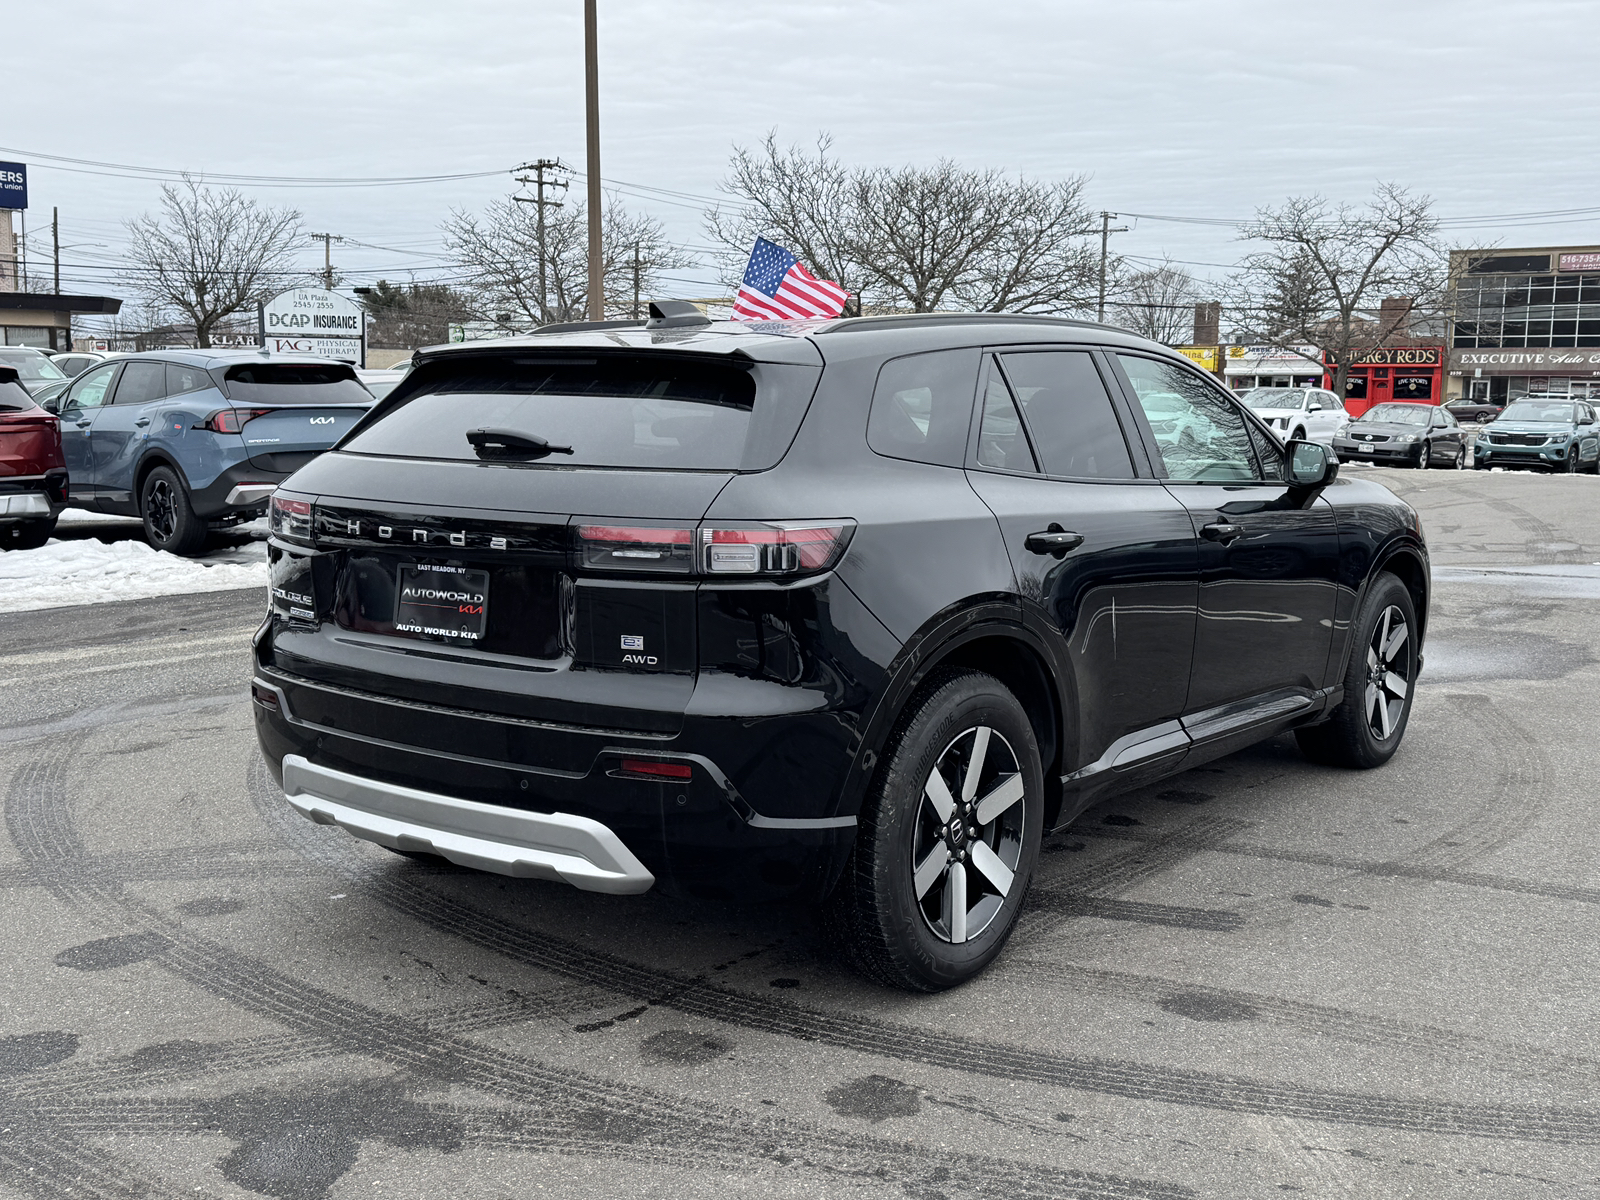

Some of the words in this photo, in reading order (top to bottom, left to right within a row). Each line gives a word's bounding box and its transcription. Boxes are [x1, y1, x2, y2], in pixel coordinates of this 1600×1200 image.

[4, 183, 23, 191] union
[269, 312, 310, 328] DCAP
[313, 315, 358, 330] INSURANCE
[317, 347, 358, 355] THERAPY
[1179, 351, 1202, 359] hina
[1396, 349, 1435, 364] REDS
[1460, 353, 1545, 364] EXECUTIVE
[1548, 352, 1585, 364] Auto
[1588, 353, 1600, 364] C
[309, 416, 335, 425] KIA
[402, 587, 484, 603] AUTOWORLD
[459, 605, 484, 614] KIA
[396, 623, 422, 633] AUTO
[424, 626, 458, 637] WORLD
[460, 631, 478, 640] KIA
[621, 654, 658, 665] AWD
